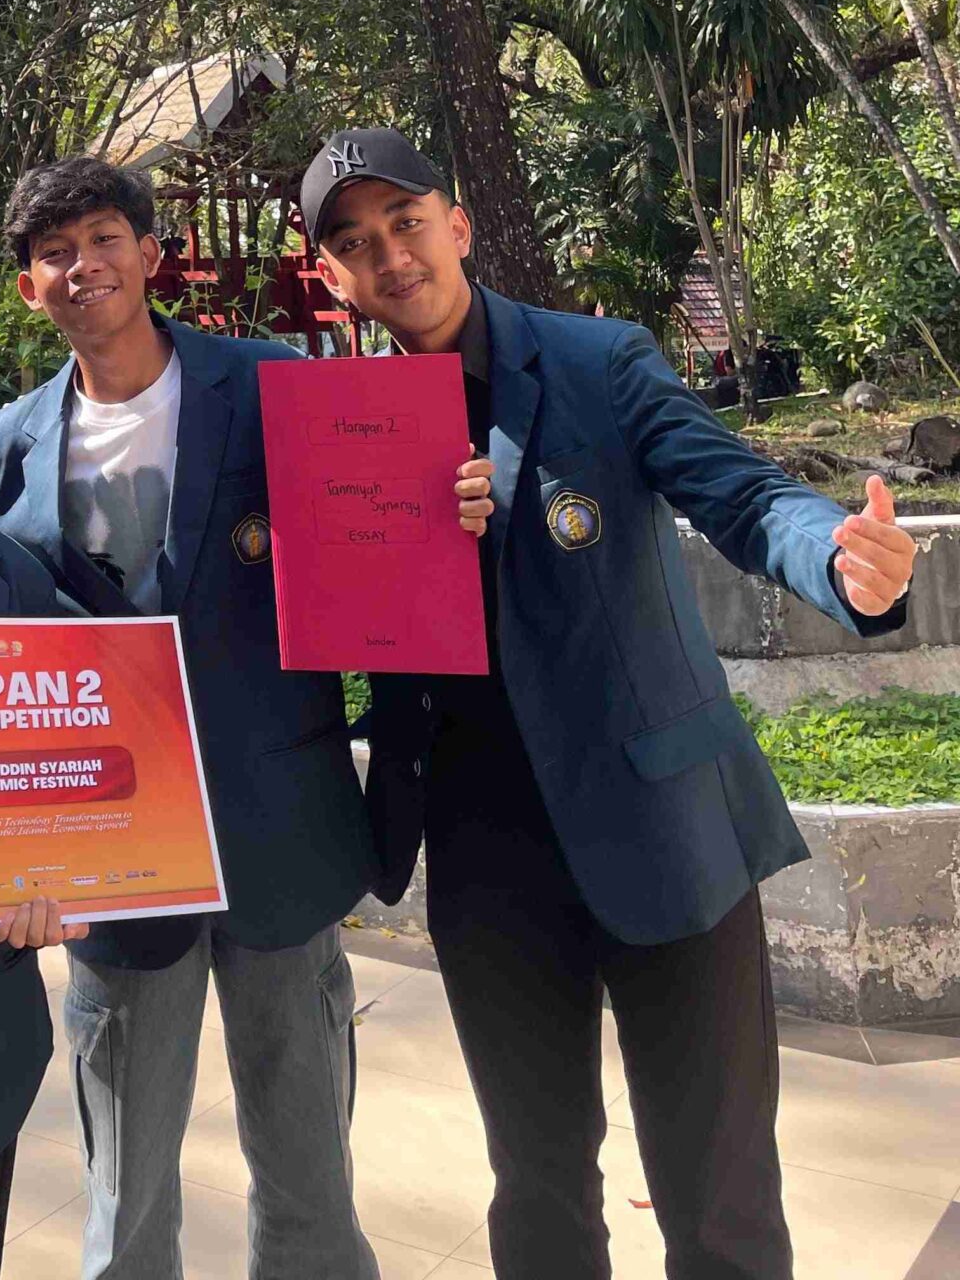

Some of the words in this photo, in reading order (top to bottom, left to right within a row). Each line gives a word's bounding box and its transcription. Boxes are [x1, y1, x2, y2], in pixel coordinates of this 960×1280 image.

[327, 140, 366, 177] NY
[331, 417, 383, 438] Harapan
[386, 417, 400, 432] 2
[322, 480, 382, 498] Tanmiyah
[369, 496, 421, 518] Synergy
[348, 530, 387, 543] ESSAY
[75, 669, 104, 704] 2
[40, 759, 103, 775] SYARIAH
[33, 774, 98, 790] FESTIVAL
